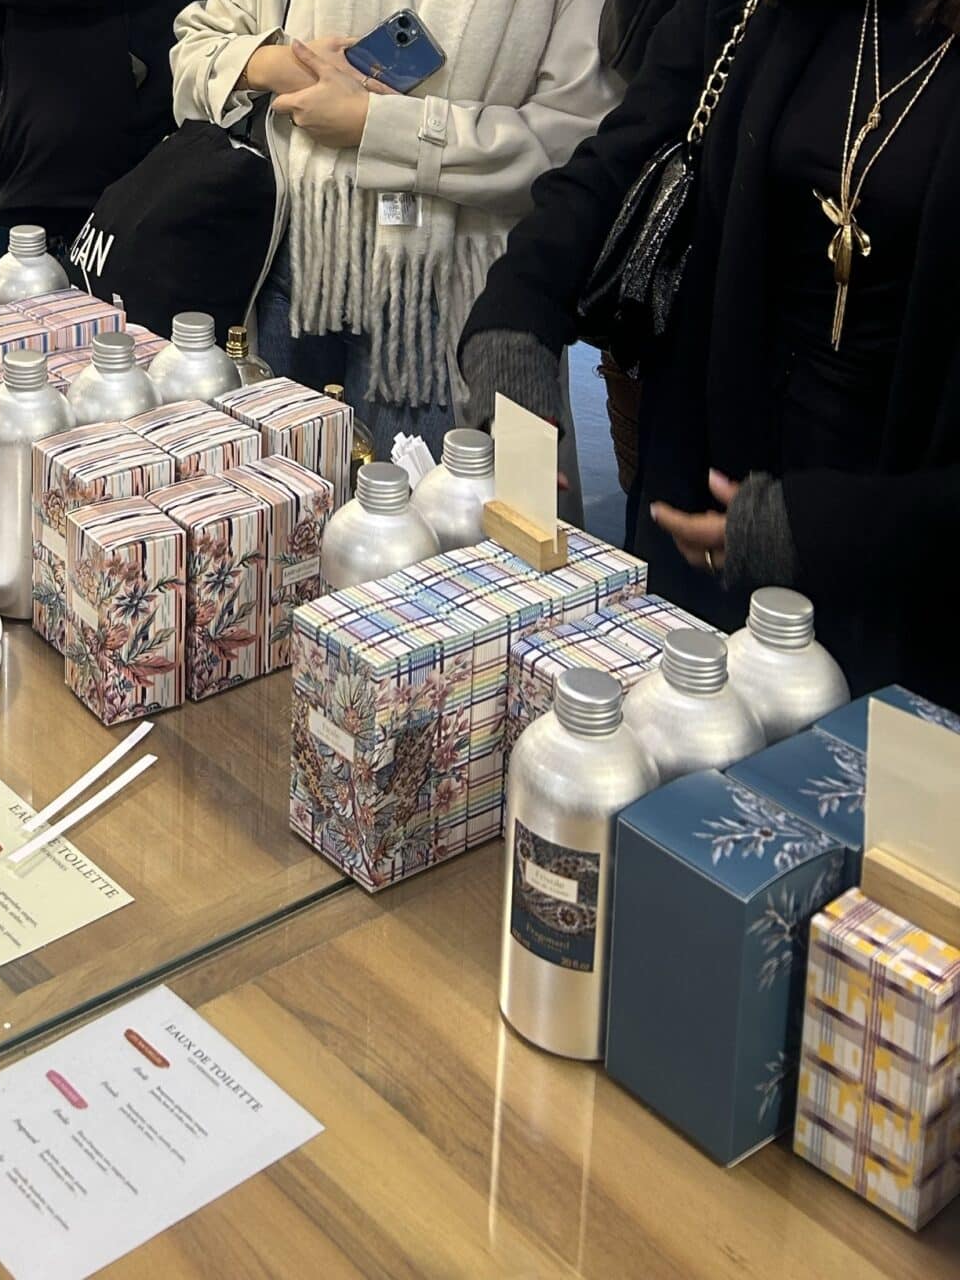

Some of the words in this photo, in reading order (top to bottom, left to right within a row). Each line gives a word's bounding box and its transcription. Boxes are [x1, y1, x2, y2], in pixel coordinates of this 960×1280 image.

[58, 846, 120, 899] TOILETTE
[165, 1024, 196, 1051] EAUX
[193, 1049, 212, 1065] DE
[209, 1063, 263, 1113] TOILETTE
